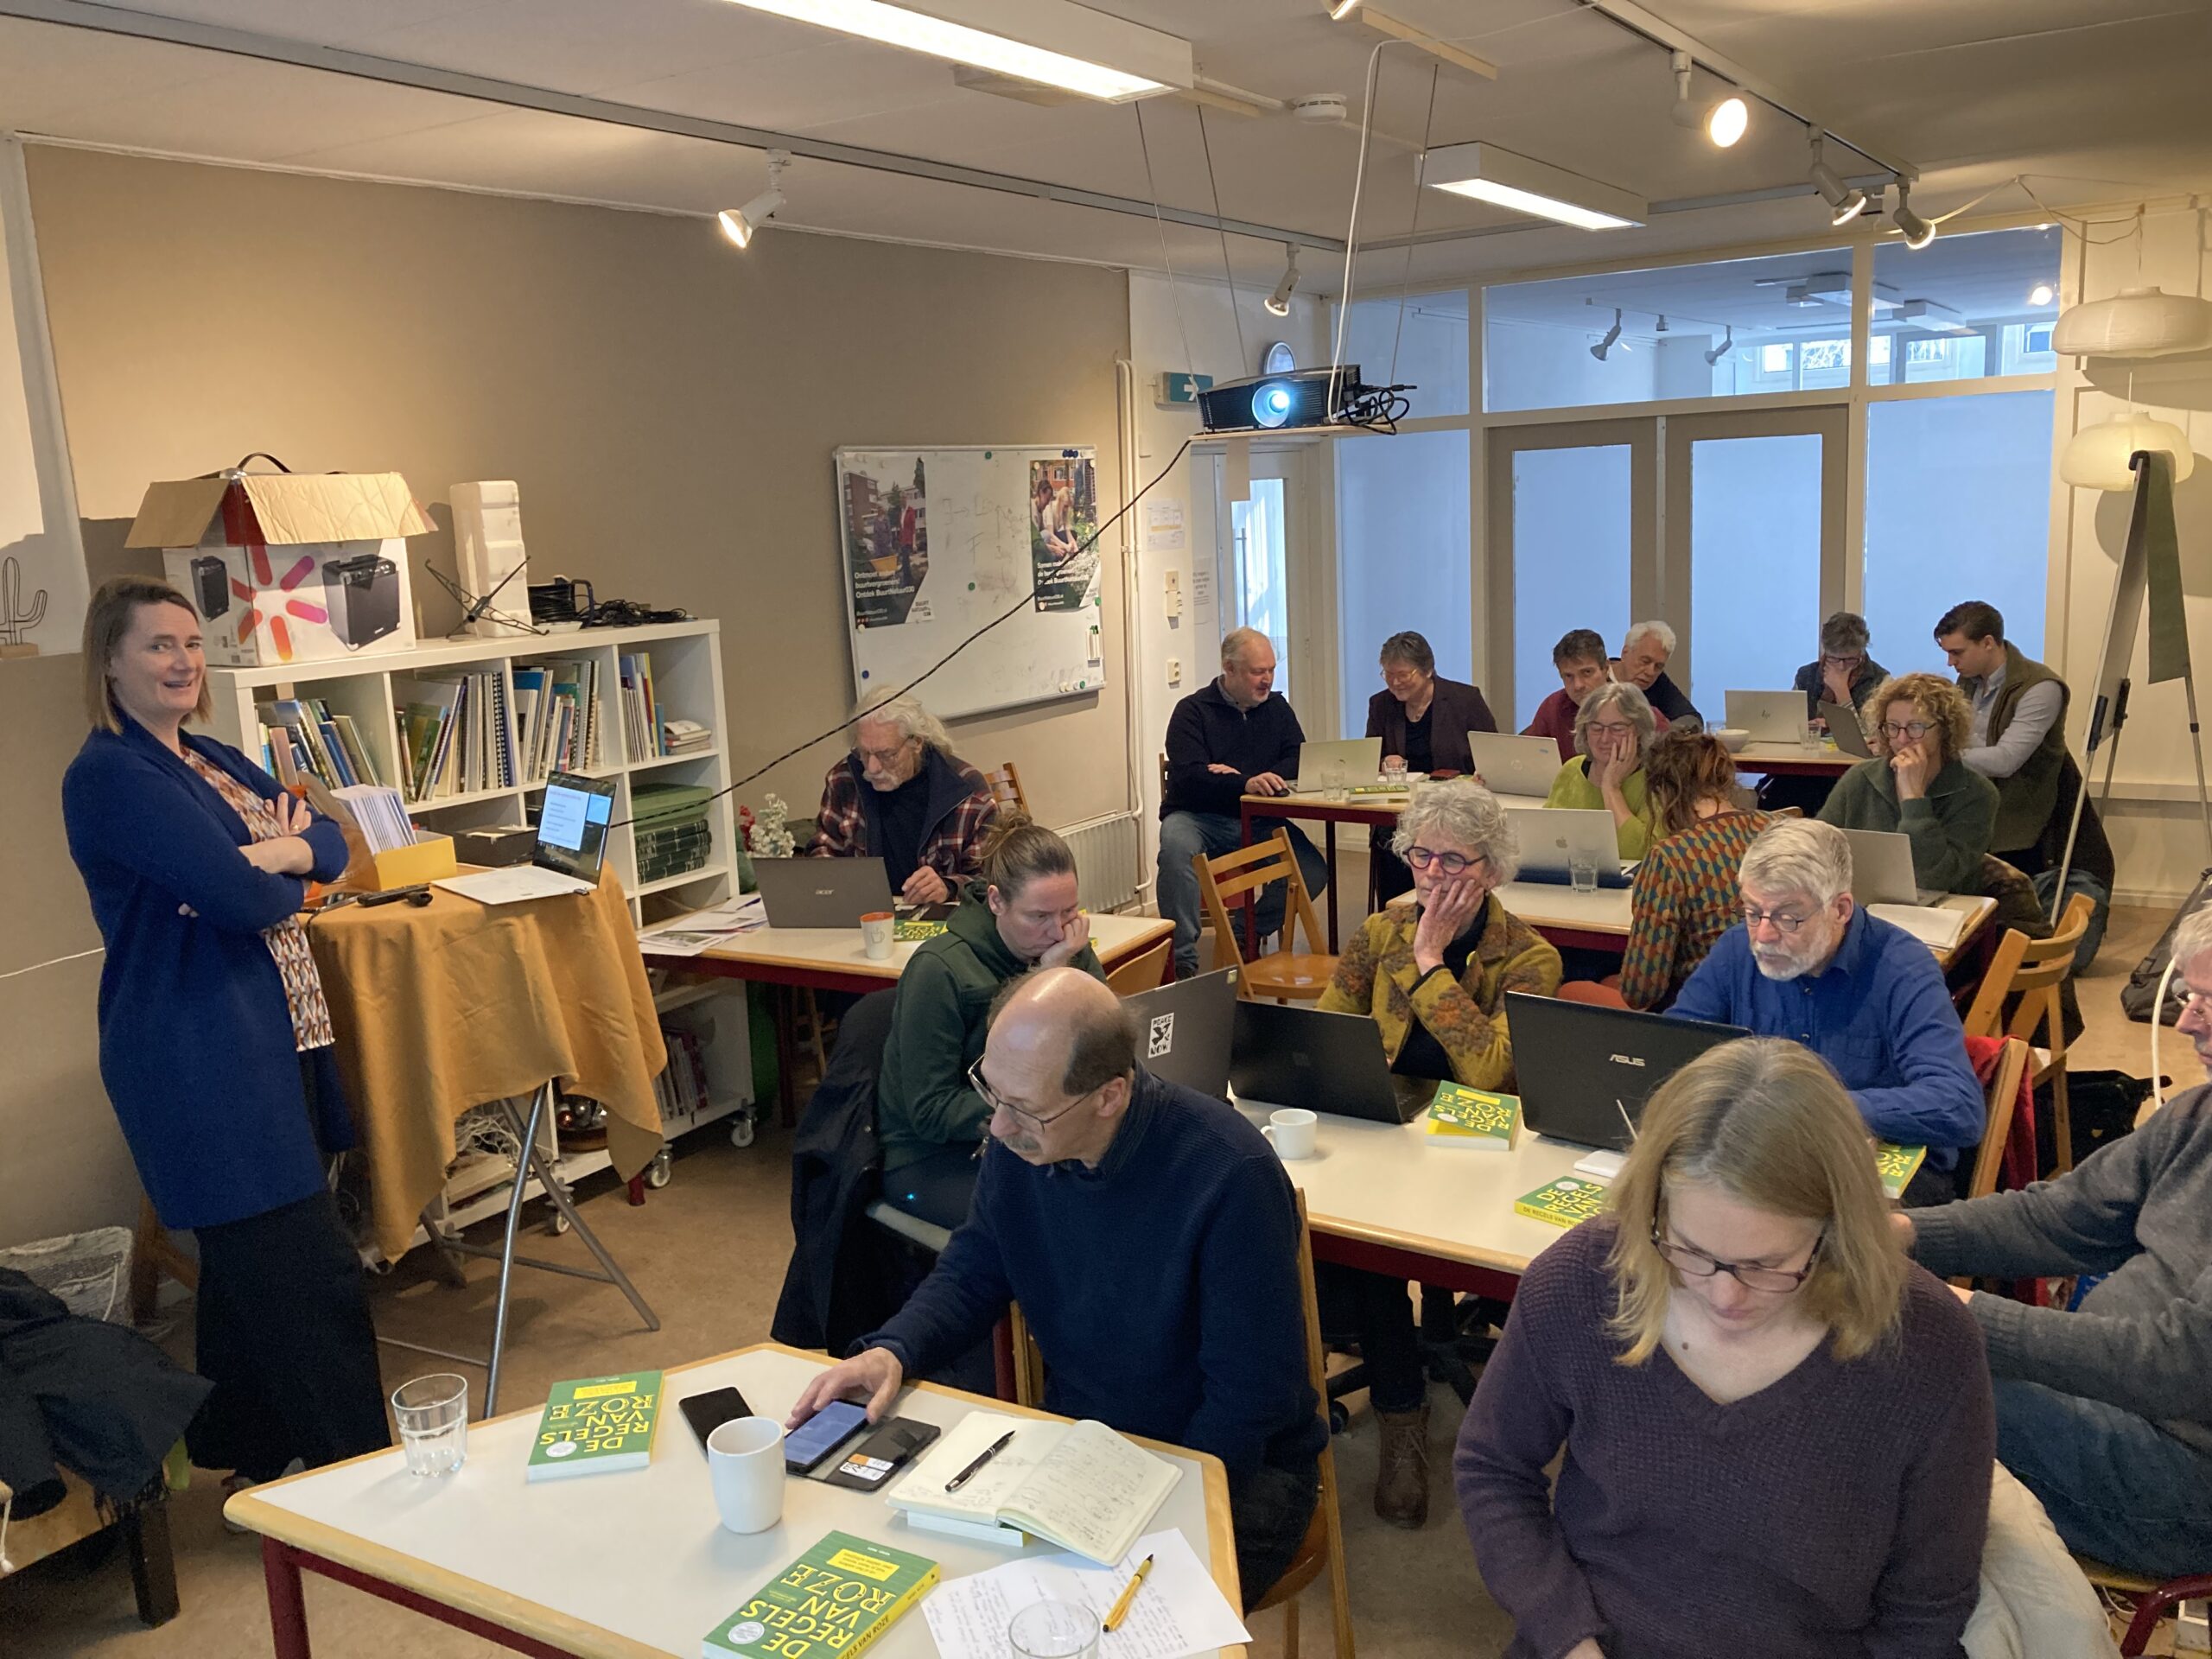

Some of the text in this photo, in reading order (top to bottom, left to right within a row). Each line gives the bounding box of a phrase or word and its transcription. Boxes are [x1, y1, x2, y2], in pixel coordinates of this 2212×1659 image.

[1150, 1044, 1167, 1055] NOW
[1609, 1053, 1646, 1067] ASUS
[1434, 1104, 1510, 1130] REGELS
[1440, 1092, 1512, 1117] ROZE
[1465, 1107, 1506, 1123] VAN
[1465, 1120, 1492, 1132] DE
[1536, 1188, 1566, 1202] DE
[1544, 1184, 1604, 1212] REGELS
[1532, 1208, 1554, 1220] REGELS
[549, 1394, 656, 1421] ROZE
[586, 1409, 645, 1427] VAN
[539, 1421, 650, 1446] REGELS
[583, 1436, 624, 1452] DE
[780, 1563, 897, 1615] ROZE
[741, 1599, 854, 1649] REGELS
[798, 1595, 861, 1629] VAN
[858, 1630, 872, 1648] VAN
[873, 1615, 890, 1635] ROZE
[760, 1632, 811, 1659] DE
